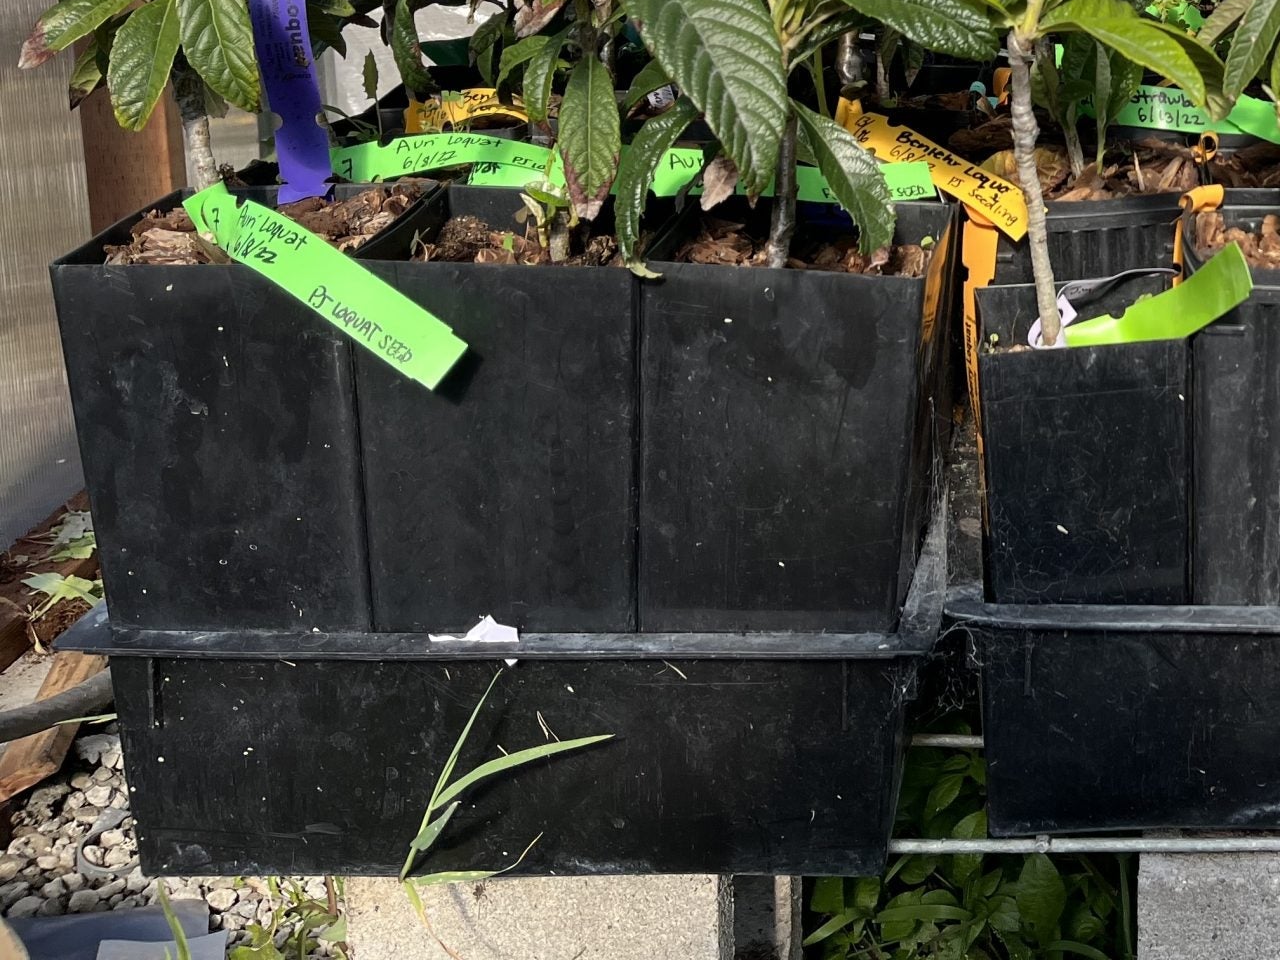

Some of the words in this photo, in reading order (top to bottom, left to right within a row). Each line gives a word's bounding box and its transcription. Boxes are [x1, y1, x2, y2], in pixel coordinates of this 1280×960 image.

[1130, 90, 1198, 106] Strawb
[1138, 108, 1205, 125] 6/13/22
[890, 146, 935, 172] 6/8/2
